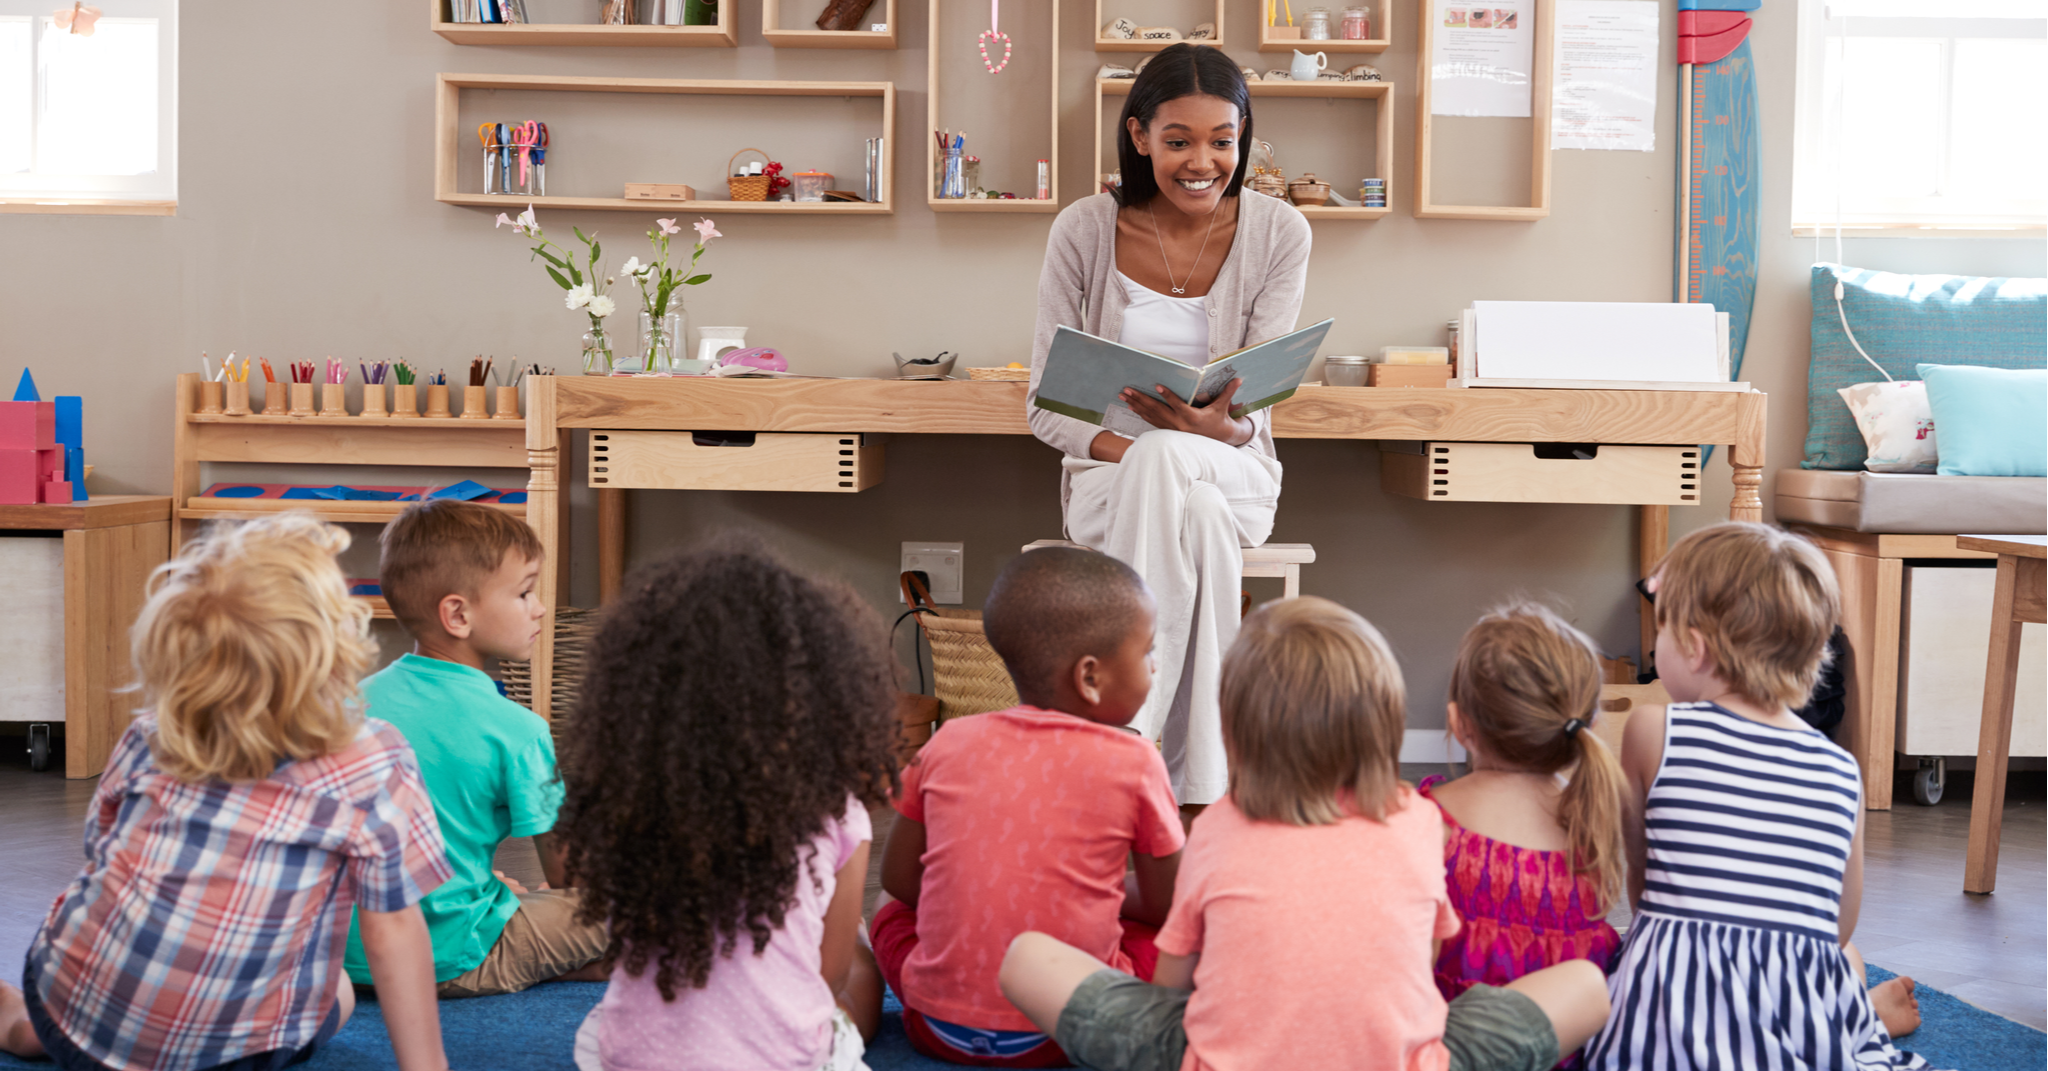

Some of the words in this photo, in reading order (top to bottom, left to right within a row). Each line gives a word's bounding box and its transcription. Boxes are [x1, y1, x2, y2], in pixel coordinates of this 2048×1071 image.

[1115, 19, 1135, 40] Joy
[1190, 29, 1210, 40] appy
[1143, 32, 1171, 40] space
[1716, 65, 1730, 75] 140
[1715, 115, 1729, 125] 130
[1714, 165, 1728, 176] 120
[1714, 216, 1727, 226] 110
[1713, 265, 1726, 275] 100
